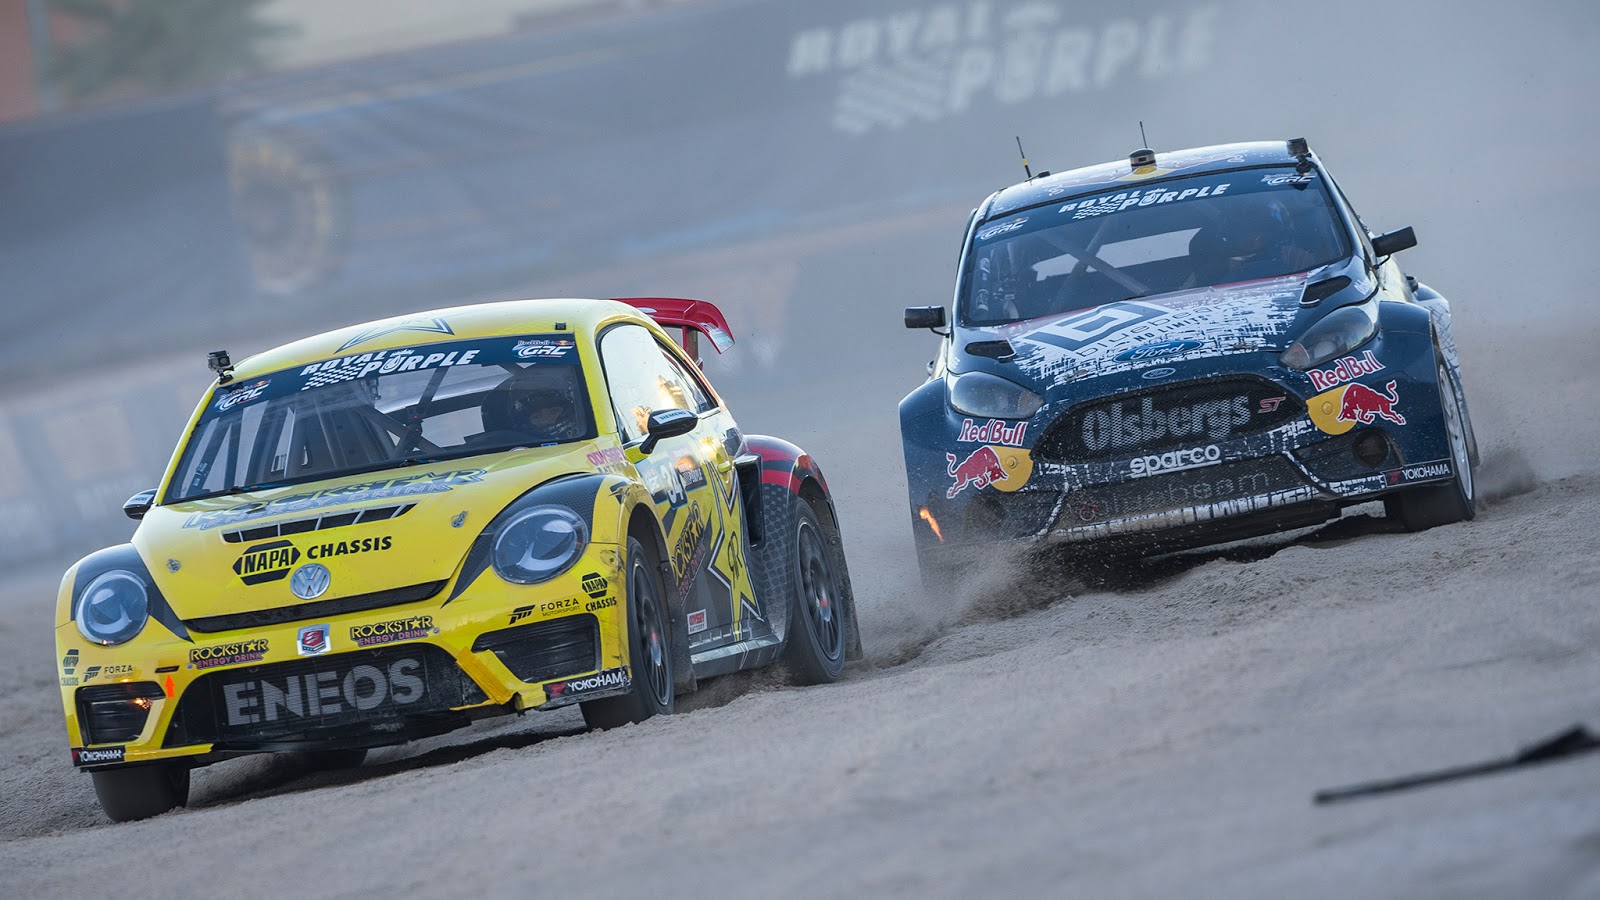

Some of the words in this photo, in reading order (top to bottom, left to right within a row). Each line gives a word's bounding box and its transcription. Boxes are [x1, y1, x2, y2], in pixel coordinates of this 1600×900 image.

[786, 0, 992, 76] ROYAL
[946, 8, 1216, 114] PURPLE
[1267, 175, 1316, 186] GRC
[1058, 191, 1142, 213] ROYAL
[1120, 183, 1231, 211] PURPLE
[1134, 332, 1155, 342] NO
[1158, 315, 1209, 333] LIMITS
[519, 345, 574, 357] GRC
[1130, 343, 1186, 360] Ford
[300, 349, 386, 377] ROYAL
[357, 349, 480, 378] PURPLE
[1149, 368, 1170, 378] Ford
[219, 383, 270, 410] GRC
[1258, 397, 1286, 414] ST
[659, 411, 687, 420] SIEMENS
[1081, 395, 1250, 451] Olsbergs
[1130, 444, 1220, 478] sparco
[1402, 463, 1450, 480] YOKOHAMA
[348, 485, 450, 502] DRINK
[660, 462, 684, 504] 34
[307, 536, 392, 560] CHASSIS
[243, 547, 292, 575] NAPA
[583, 577, 606, 593] NAPA
[541, 598, 580, 612] FORZA
[585, 596, 617, 612] CHASSIS
[350, 616, 433, 640] ROCKSTAR
[357, 632, 395, 646] ENERGY
[397, 629, 428, 641] DRINK
[190, 639, 269, 663] ROCKSTAR
[197, 656, 231, 668] ENERGY
[234, 651, 263, 663] DRINK
[104, 664, 133, 674] FORZA
[223, 658, 425, 727] ENEOS
[78, 748, 122, 763] YOKOHAMA
